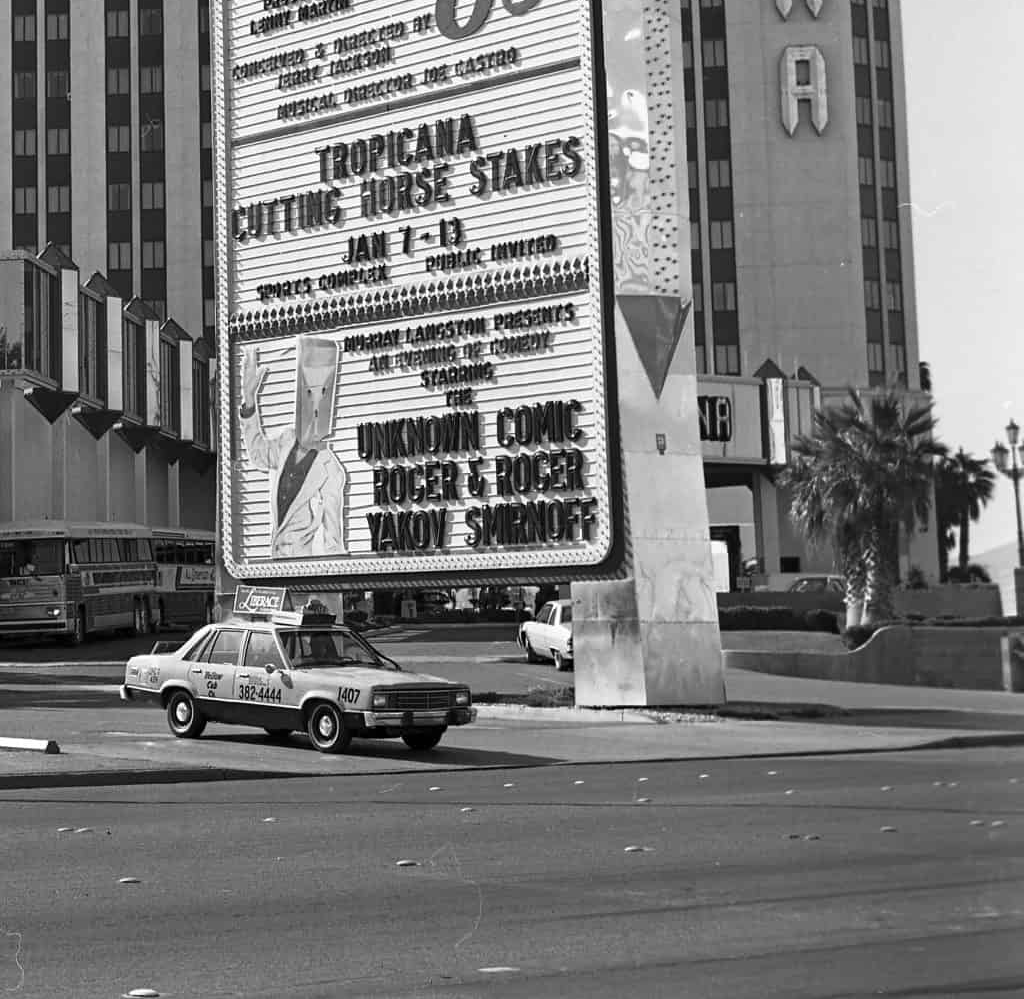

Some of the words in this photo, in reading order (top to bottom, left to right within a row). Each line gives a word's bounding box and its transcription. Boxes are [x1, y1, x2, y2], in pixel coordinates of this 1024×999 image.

[232, 48, 306, 81] CONCEIVED
[333, 20, 406, 54] DIRECTED
[412, 12, 433, 33] BY
[249, 10, 291, 35] LENNY
[277, 92, 337, 120] MUSICAL
[343, 72, 413, 104] DIRECTOR
[423, 64, 450, 87] JOE
[454, 46, 518, 77] CASTRO
[278, 65, 319, 90] JERRY
[330, 46, 394, 77] JACKSON
[314, 113, 477, 183] TROPICANA
[232, 185, 345, 241] CUTTING
[360, 163, 454, 219] HORSE
[469, 135, 584, 198] STAKES
[342, 232, 388, 264] JAN
[398, 225, 414, 255] 7
[439, 217, 464, 247] 13
[256, 275, 312, 302] SPORTS
[318, 263, 389, 290] COMPLEX
[425, 247, 482, 273] PUBLIC
[490, 233, 558, 262] INVITED
[343, 329, 400, 353] MURRAY
[405, 316, 487, 345] LANGSTON
[493, 302, 576, 331] PRESENTS
[368, 354, 390, 373] AN
[393, 344, 456, 368] EVENING
[463, 340, 483, 359] OF
[489, 331, 552, 354] COMEDY
[419, 361, 494, 388] STARRING
[445, 386, 473, 407] THE
[357, 411, 479, 460] UNKNOWN
[496, 399, 583, 448] COMIC
[365, 508, 448, 553] YAKOV
[464, 495, 598, 547] SMIRNOFF
[239, 684, 282, 703] 382-4444
[337, 686, 361, 705] 1407
